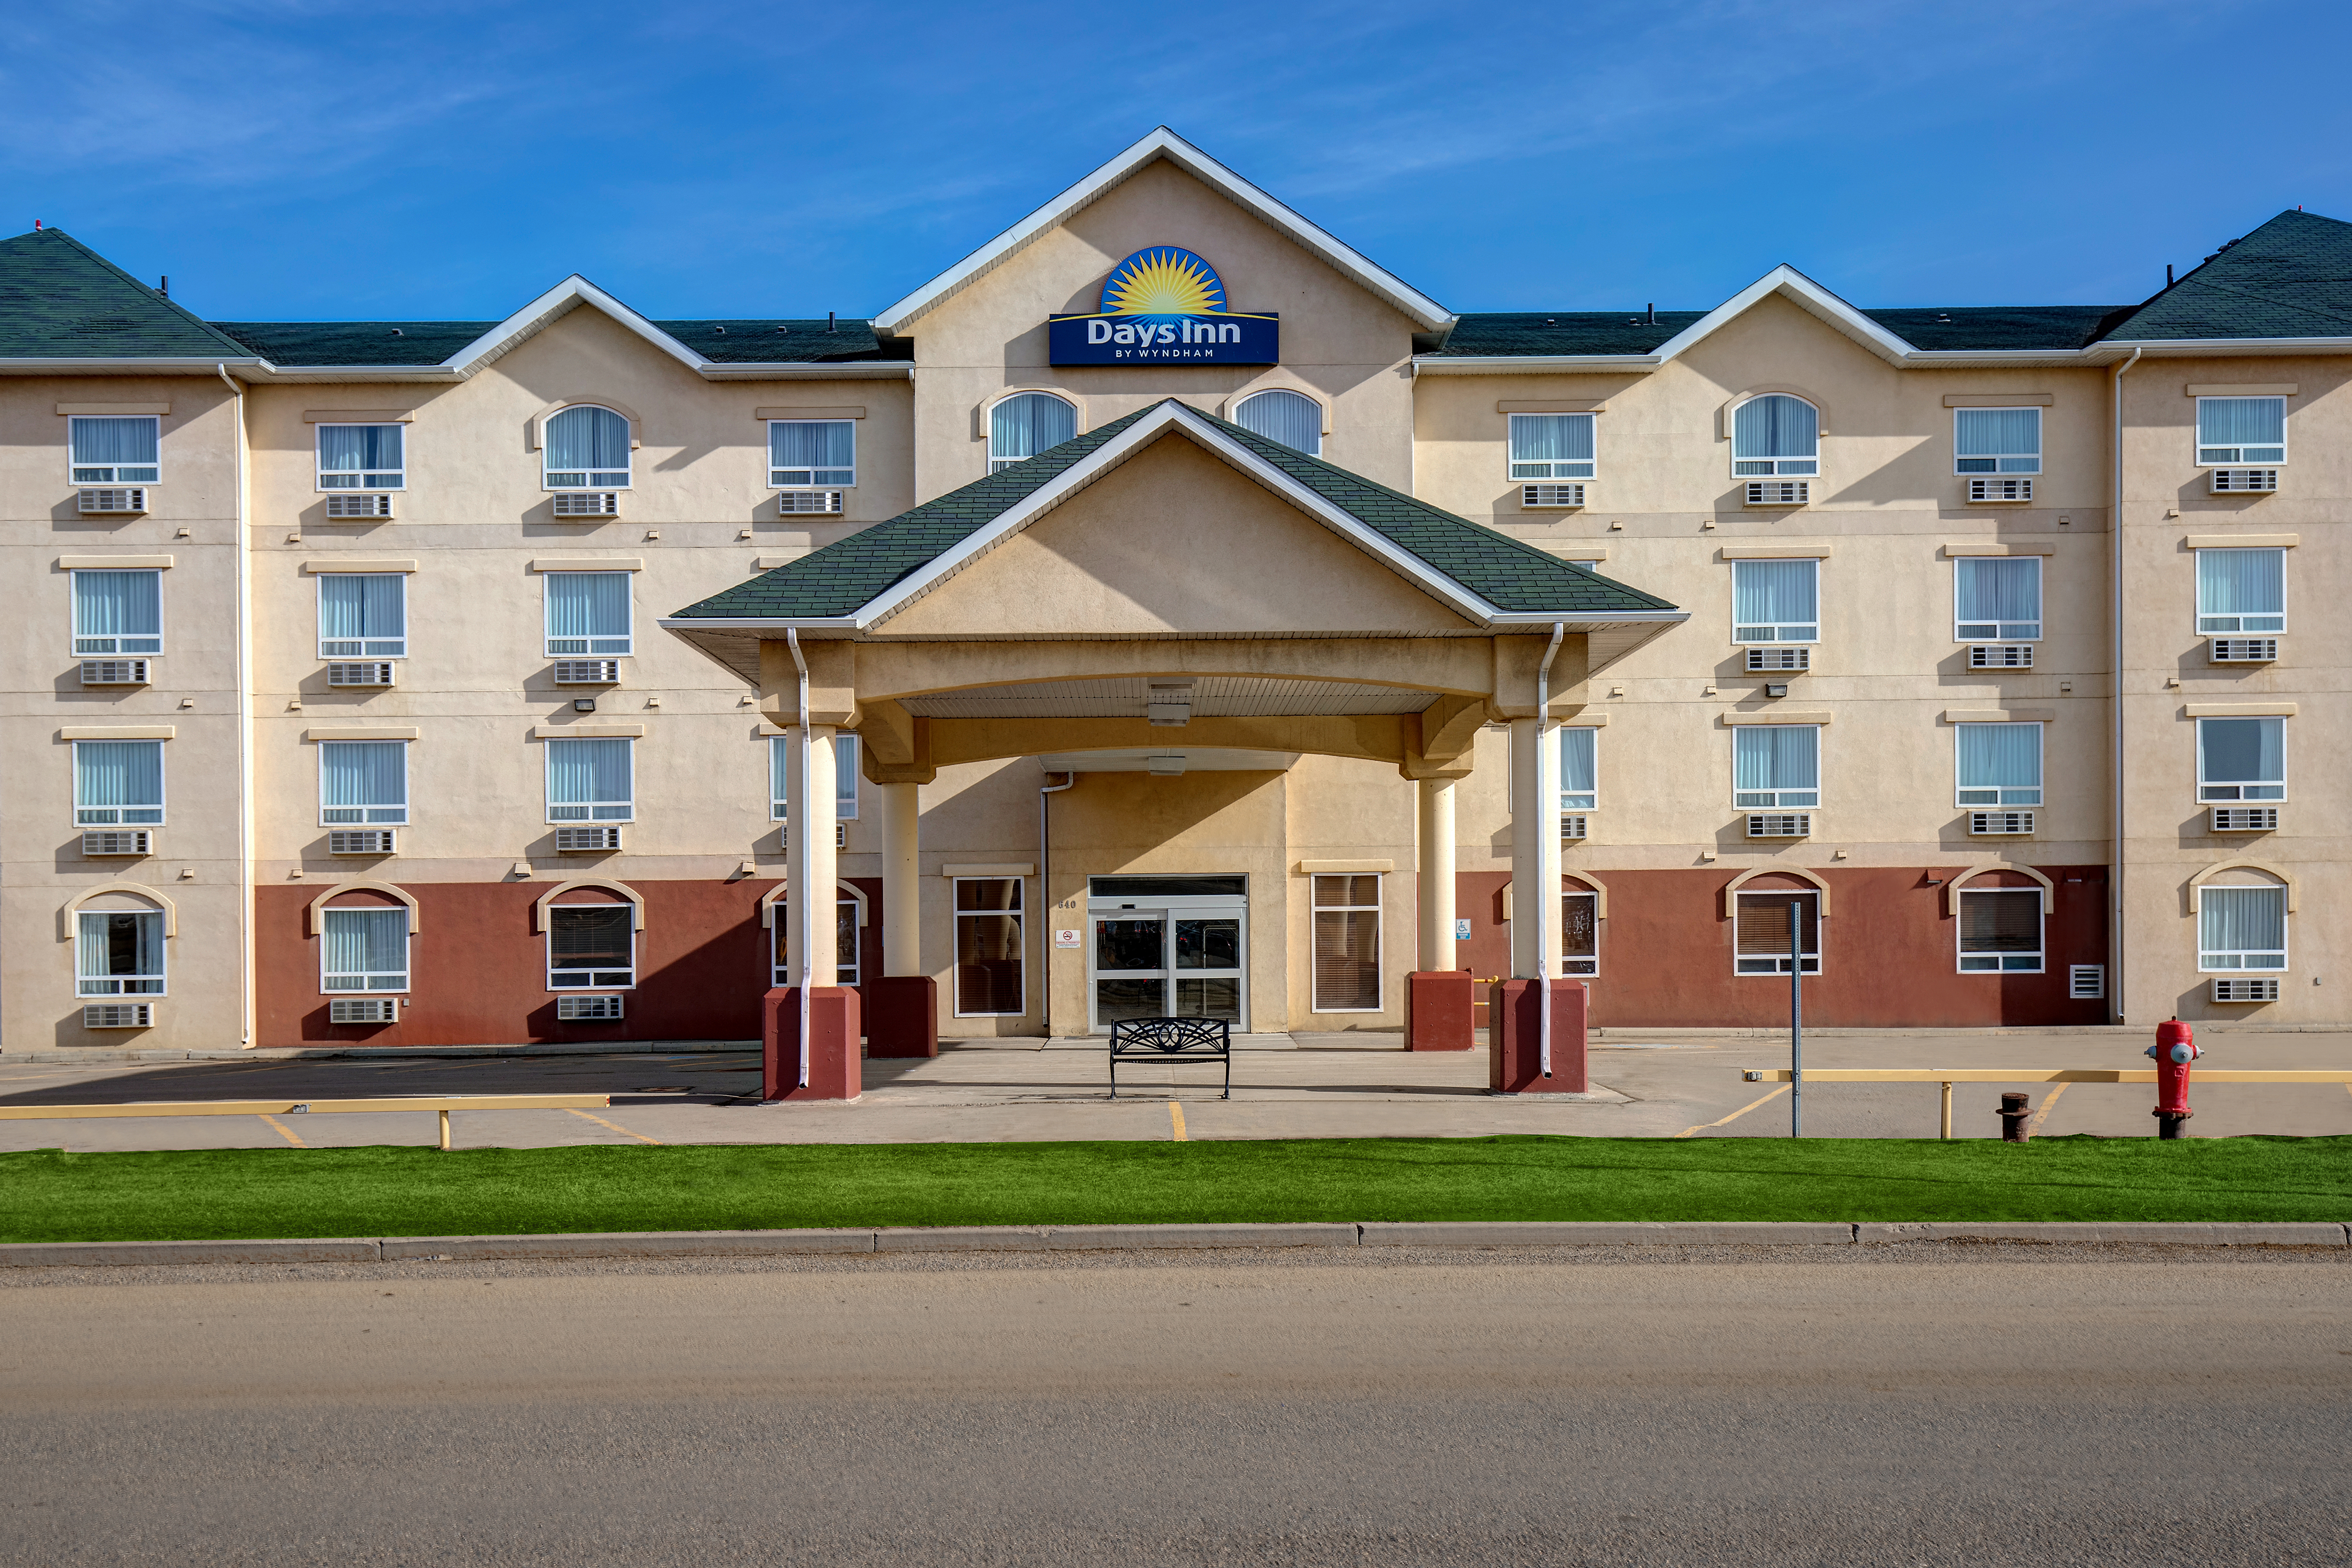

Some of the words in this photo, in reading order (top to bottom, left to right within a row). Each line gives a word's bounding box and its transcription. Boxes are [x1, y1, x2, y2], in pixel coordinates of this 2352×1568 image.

[1088, 320, 1176, 347] Days
[1183, 319, 1240, 343] Inn
[1058, 900, 1076, 908] 640
